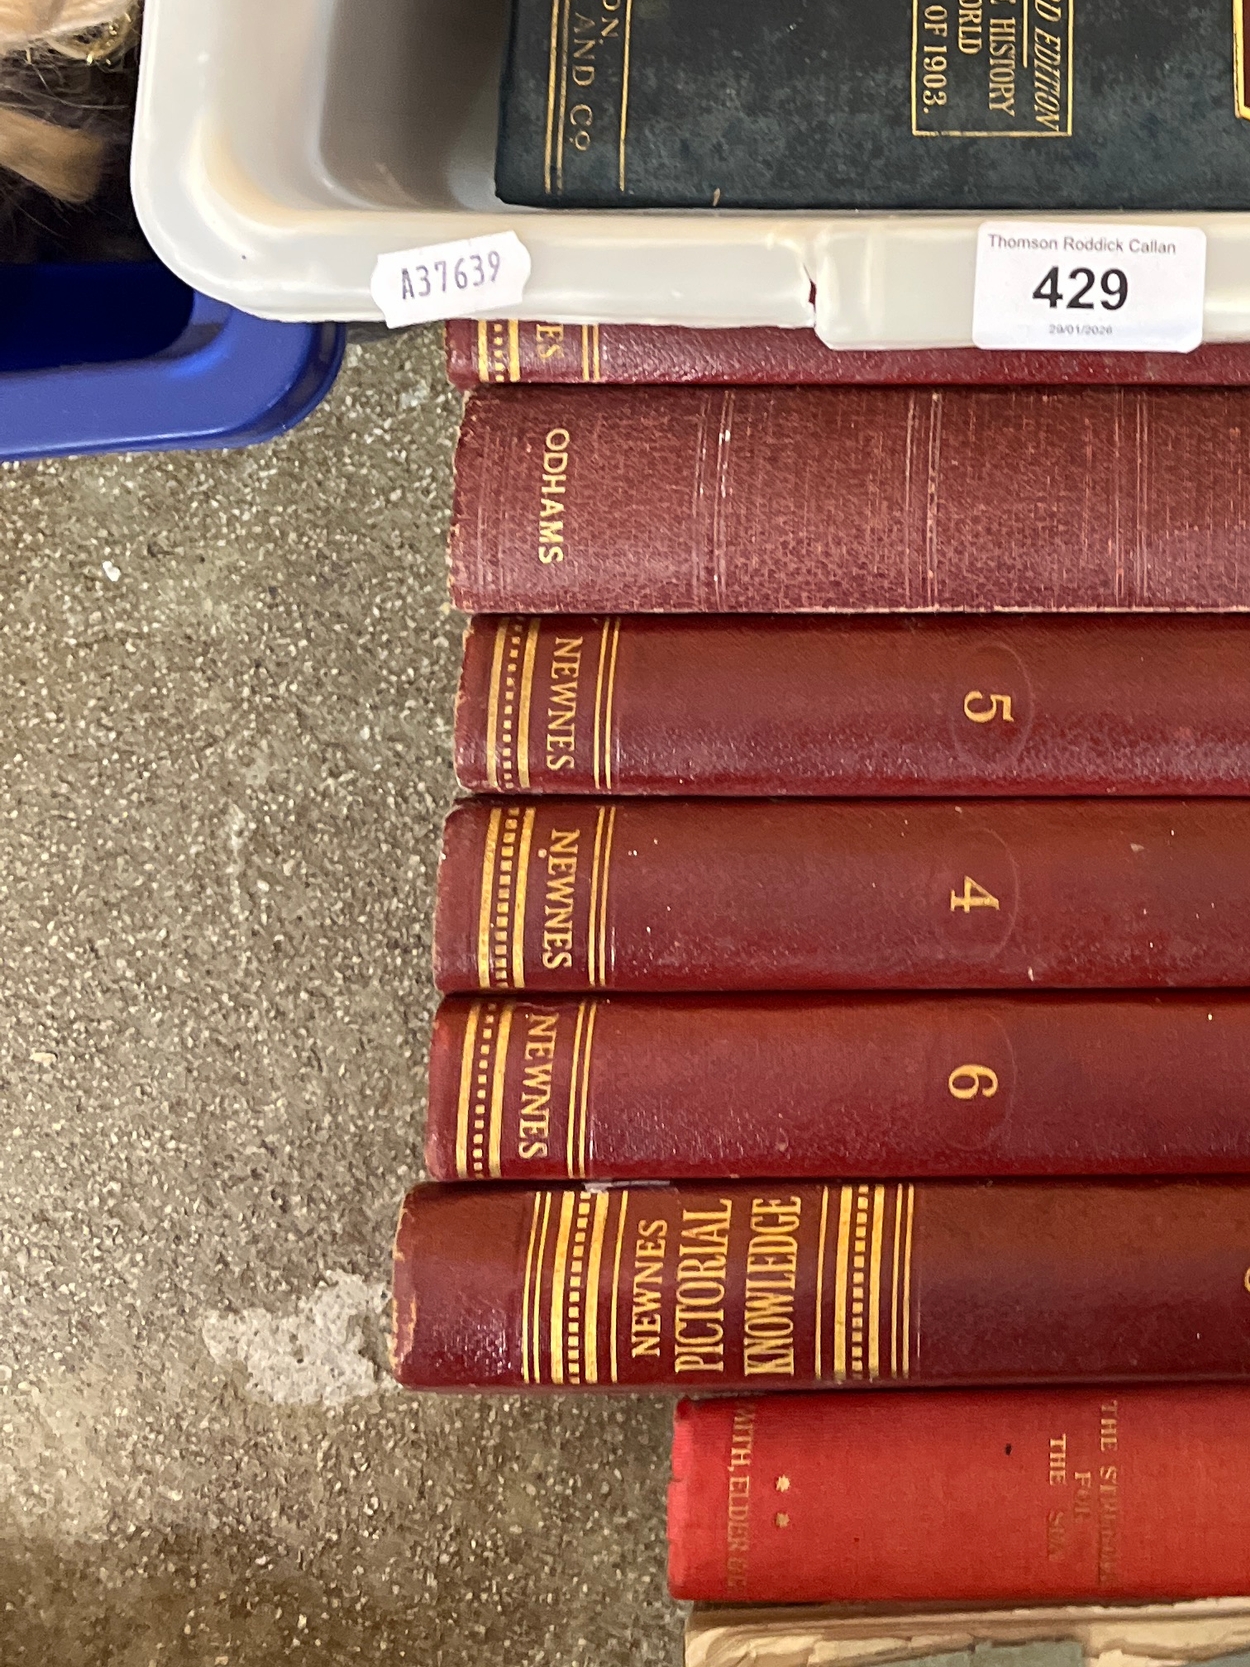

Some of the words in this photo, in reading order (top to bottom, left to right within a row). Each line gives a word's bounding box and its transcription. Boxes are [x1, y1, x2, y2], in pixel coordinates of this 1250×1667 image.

[571, 12, 597, 88] AND
[922, 3, 949, 39] OF
[921, 44, 948, 115] 1903.
[987, 16, 1016, 118] HISTORY
[1033, 25, 1062, 131] EDITION
[400, 250, 501, 301] A37639
[988, 232, 1059, 250] Thomson
[1062, 235, 1124, 253] Roddick
[1128, 237, 1177, 255] Callan
[1031, 265, 1129, 311] 429
[537, 427, 571, 565] ODHAMS
[545, 636, 584, 773] NEWNES
[962, 689, 1015, 725] 5
[540, 827, 581, 971] NEWNES
[949, 874, 1001, 914] 4
[517, 1011, 561, 1160] NEWNES
[947, 1063, 1000, 1101] 6
[630, 1218, 669, 1359] NEWNES
[673, 1197, 734, 1375] PICTORIAL
[742, 1195, 803, 1378] KNOWLEDGE
[728, 1405, 757, 1472] MITH,
[1048, 1433, 1067, 1487] THE
[1100, 1399, 1118, 1452] THE
[727, 1475, 752, 1552] ELDER
